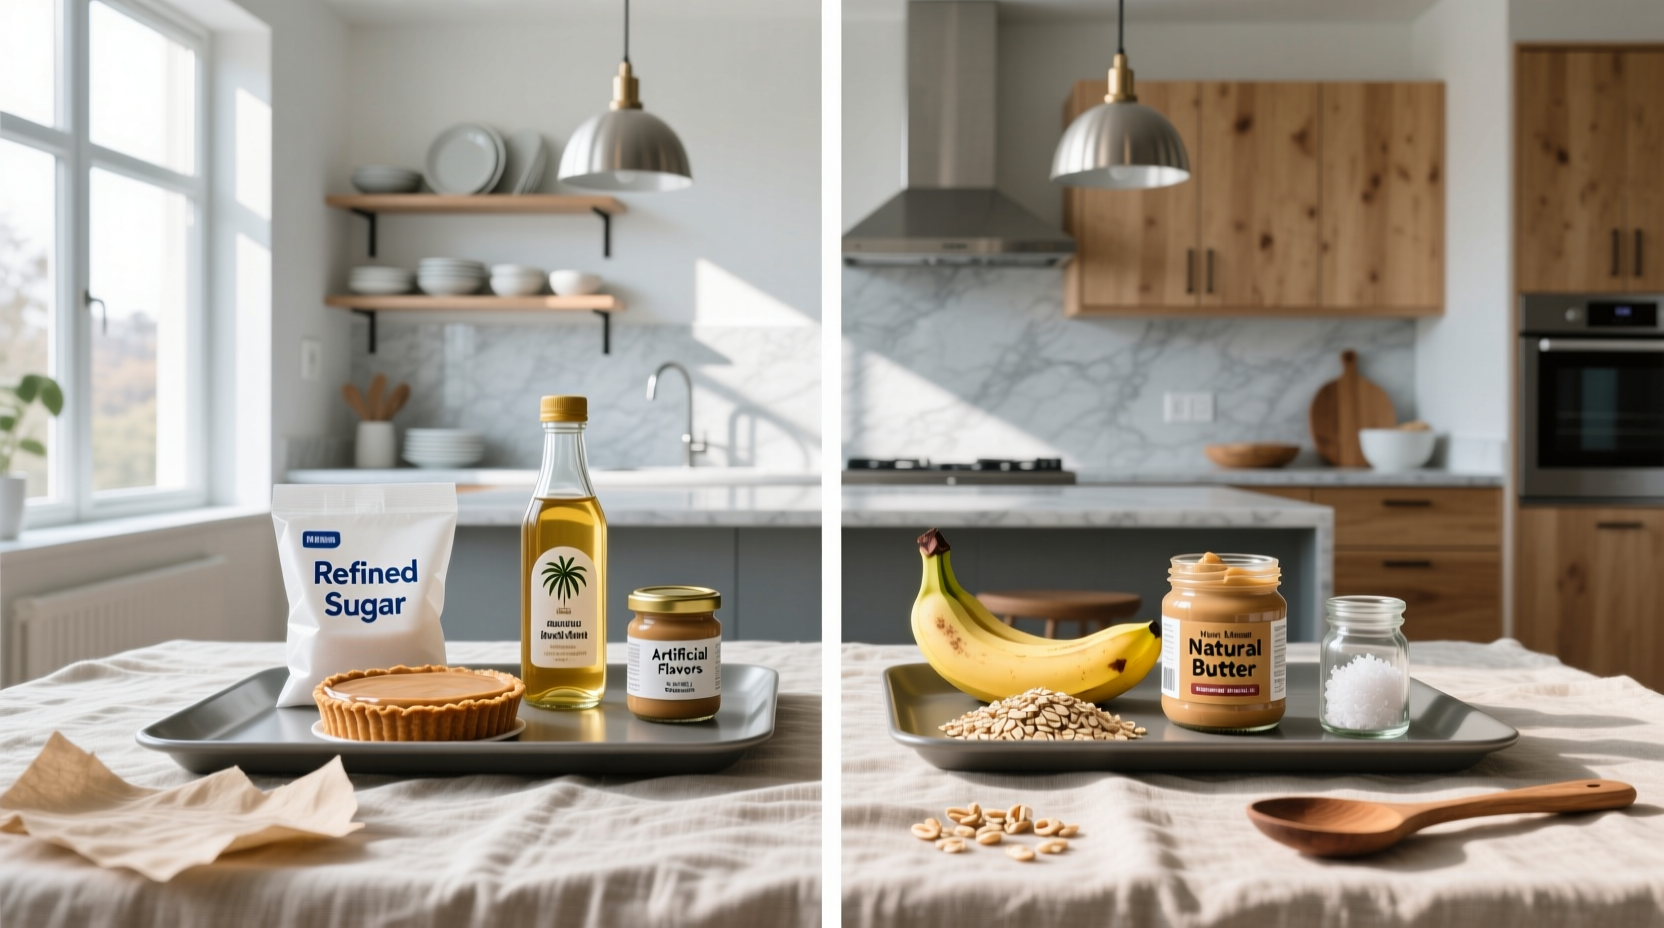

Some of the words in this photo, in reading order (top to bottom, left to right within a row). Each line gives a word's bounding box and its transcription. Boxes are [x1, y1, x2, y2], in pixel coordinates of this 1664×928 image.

[314, 559, 418, 585] Refined
[324, 591, 407, 624] Sugar
[652, 647, 708, 661] Artificial
[1189, 637, 1262, 657] Natural
[658, 663, 703, 675] Flavors
[1192, 658, 1256, 677] Butter
